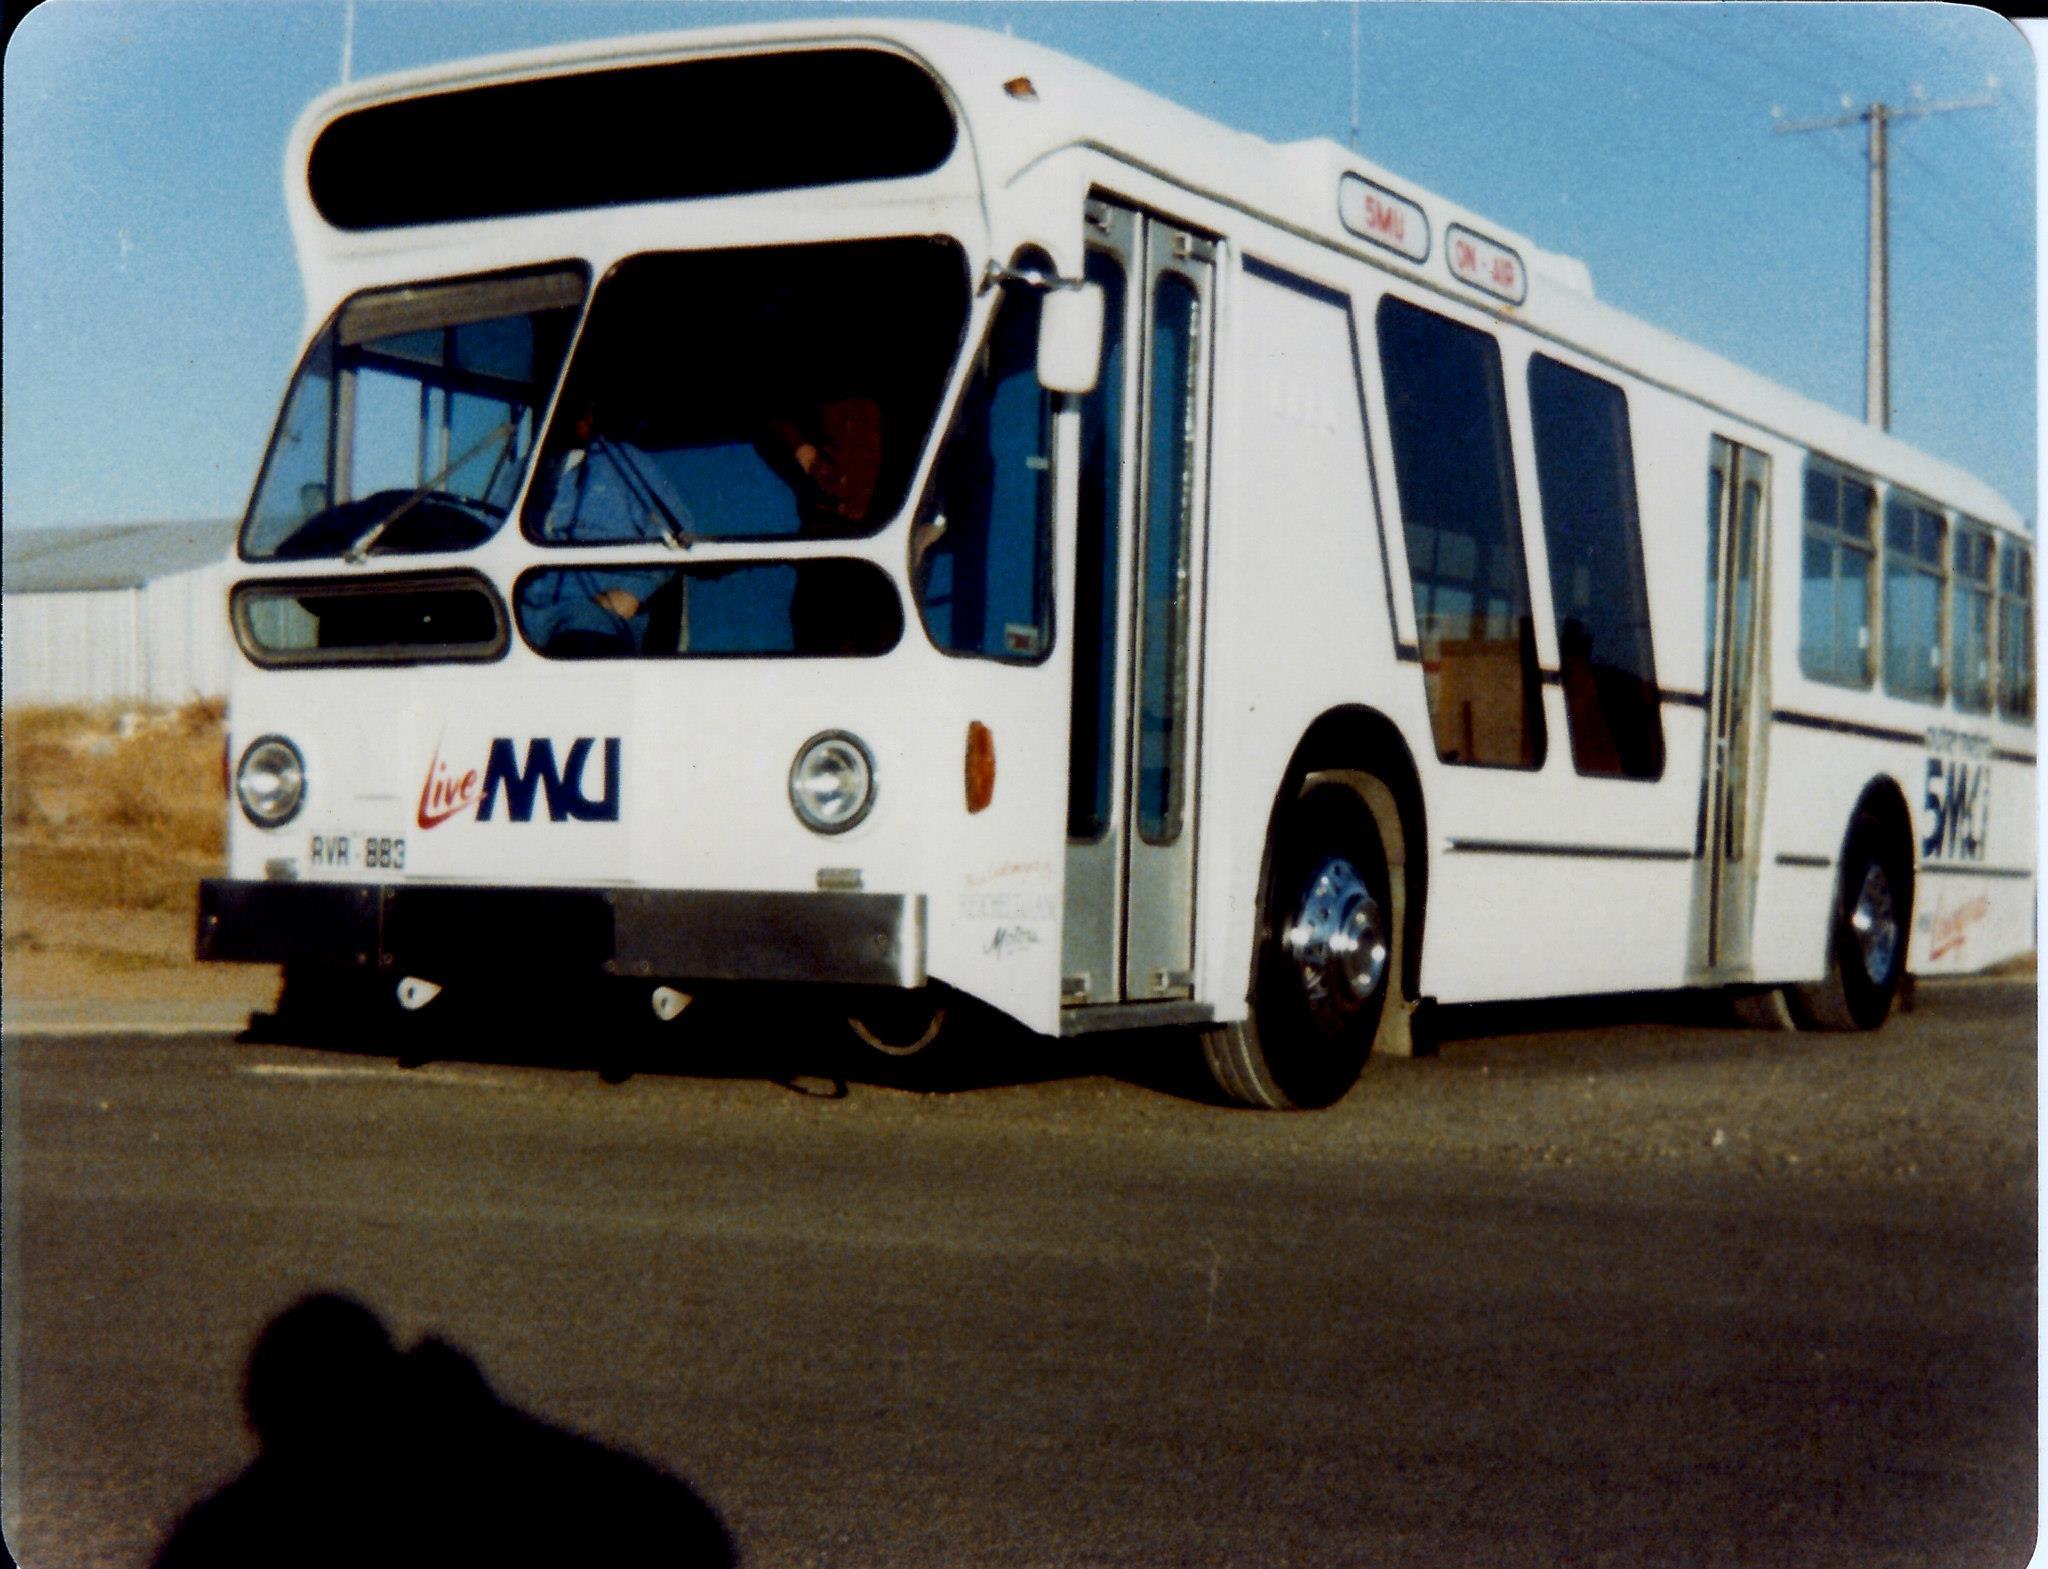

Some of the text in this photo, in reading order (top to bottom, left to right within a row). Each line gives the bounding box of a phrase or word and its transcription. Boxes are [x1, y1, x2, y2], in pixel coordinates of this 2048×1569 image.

[1365, 194, 1404, 241] 5MU
[1455, 239, 1476, 272] ON
[1491, 256, 1515, 288] AIR
[417, 722, 621, 830] Live MU
[1922, 757, 1990, 862] 5MU
